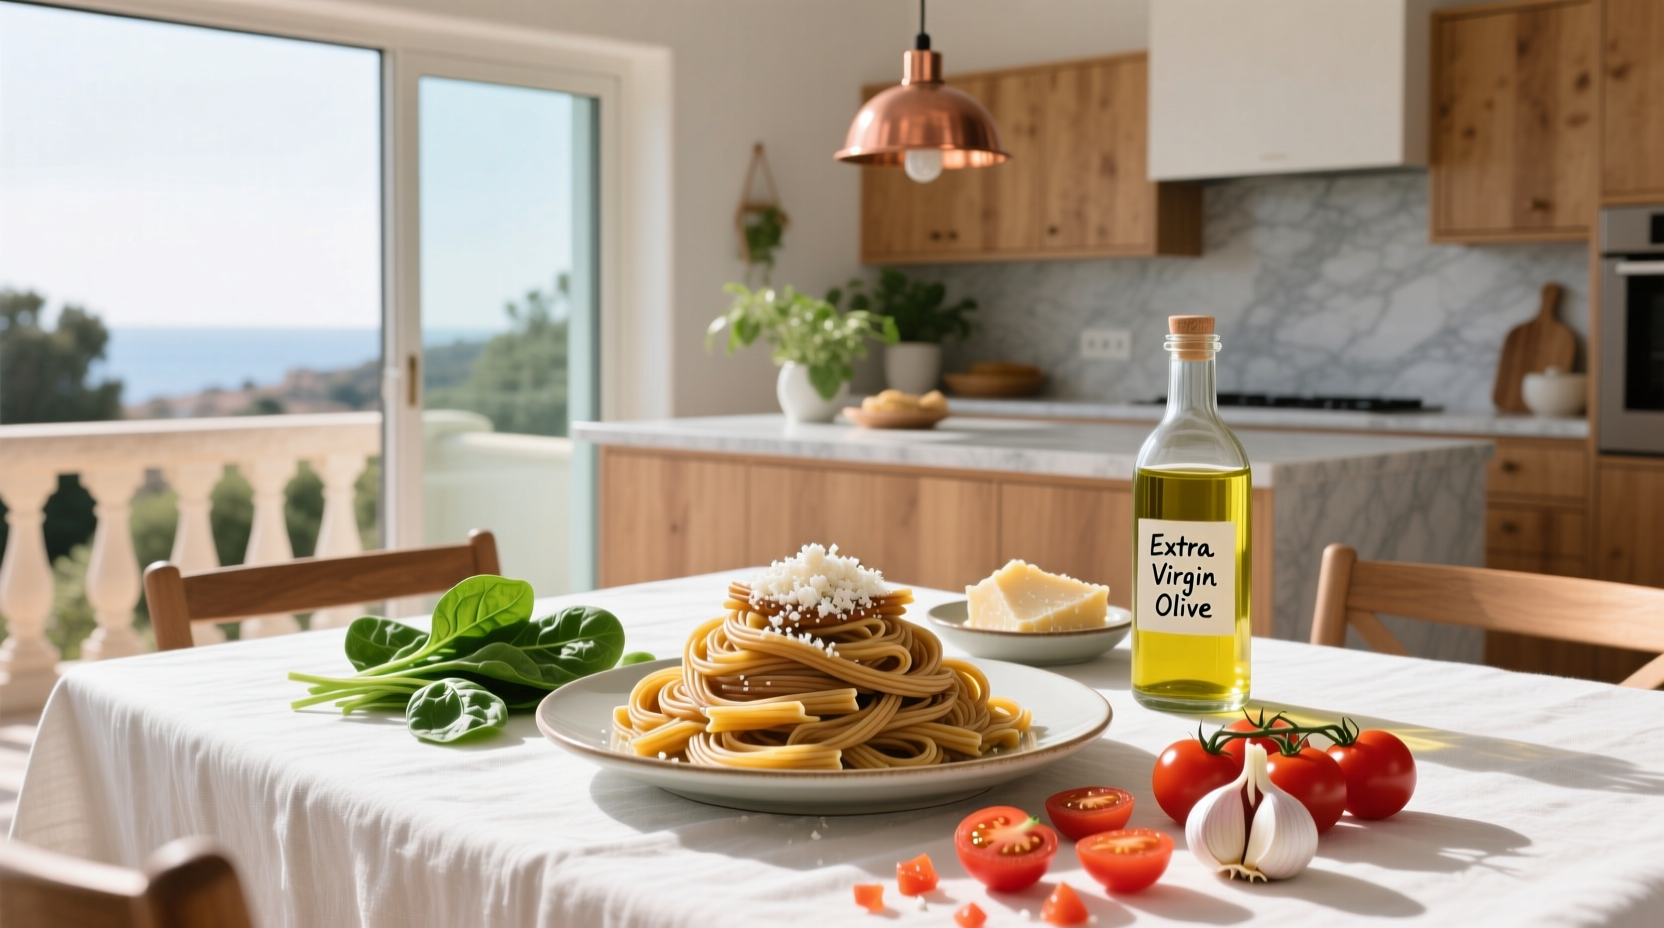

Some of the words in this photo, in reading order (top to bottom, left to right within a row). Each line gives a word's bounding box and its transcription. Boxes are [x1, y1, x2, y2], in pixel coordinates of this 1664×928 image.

[1151, 533, 1215, 558] Extra
[1152, 562, 1218, 597] Virgin
[1155, 593, 1213, 619] Olive
